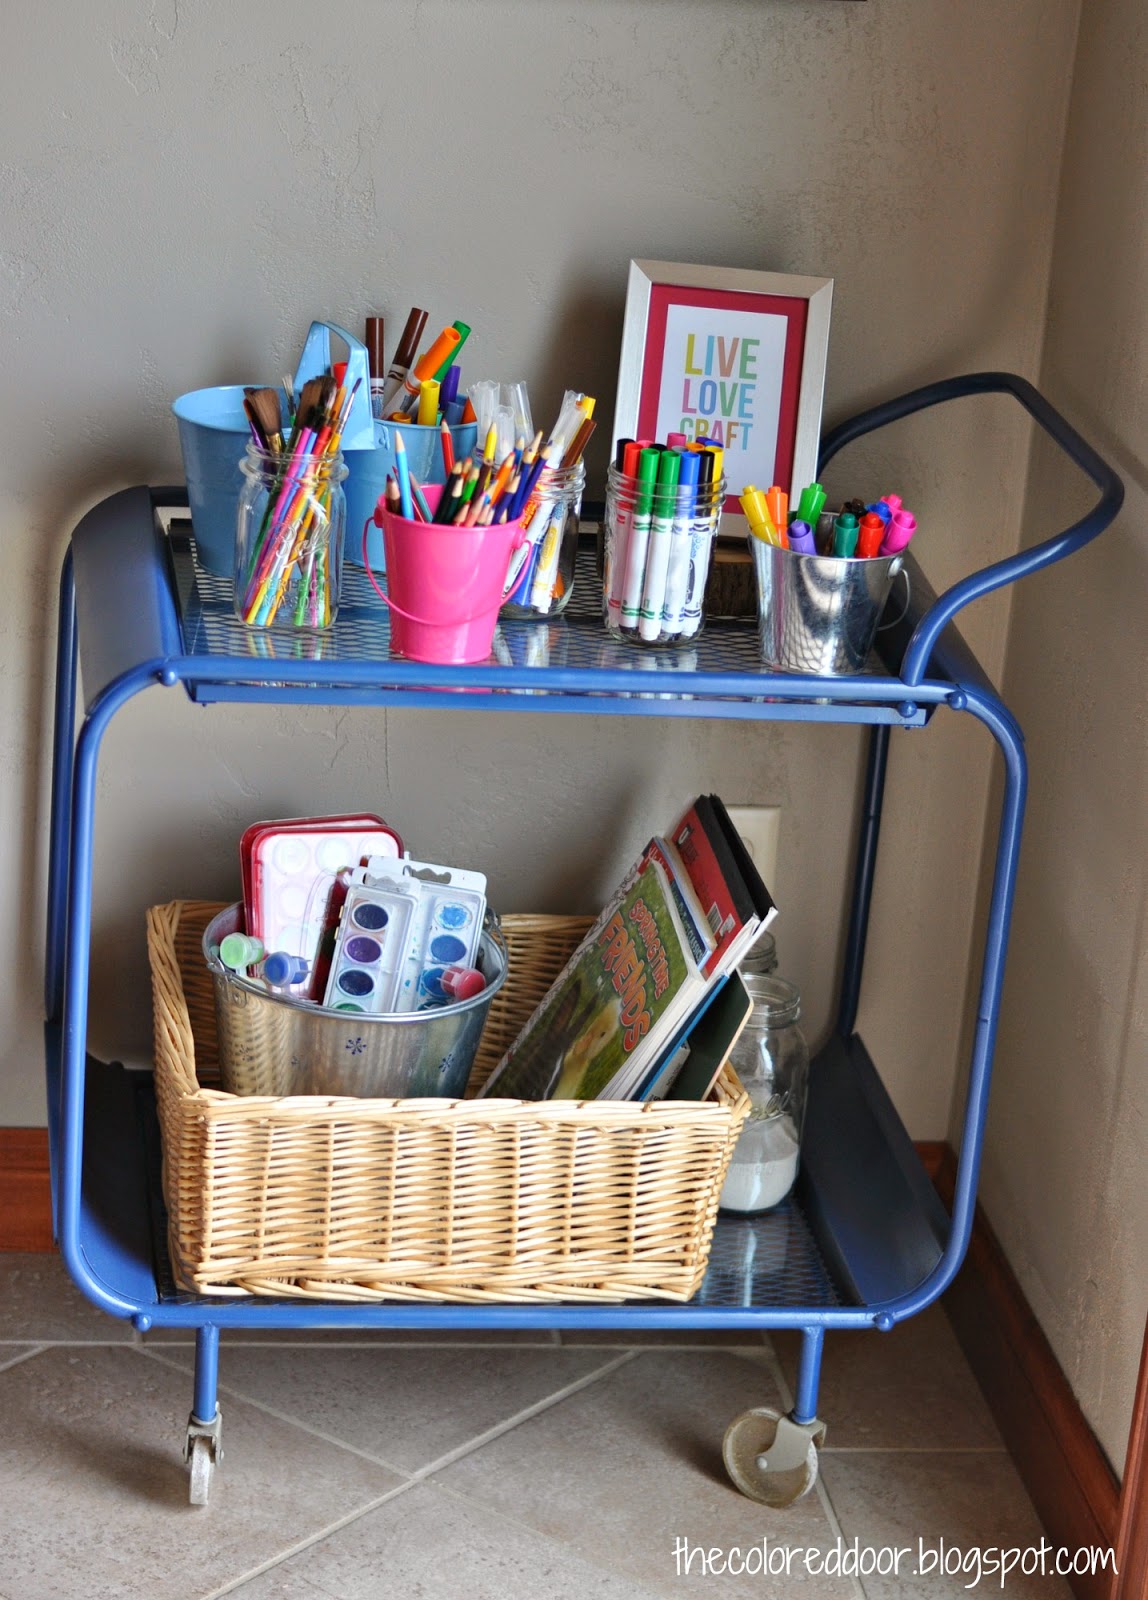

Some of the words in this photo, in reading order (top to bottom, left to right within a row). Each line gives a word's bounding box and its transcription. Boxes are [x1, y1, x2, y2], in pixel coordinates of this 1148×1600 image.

[684, 333, 760, 380] LIVE
[681, 378, 756, 419] LOVE
[598, 911, 650, 1052] FRIENDS
[629, 898, 670, 1000] SPRINGTIME
